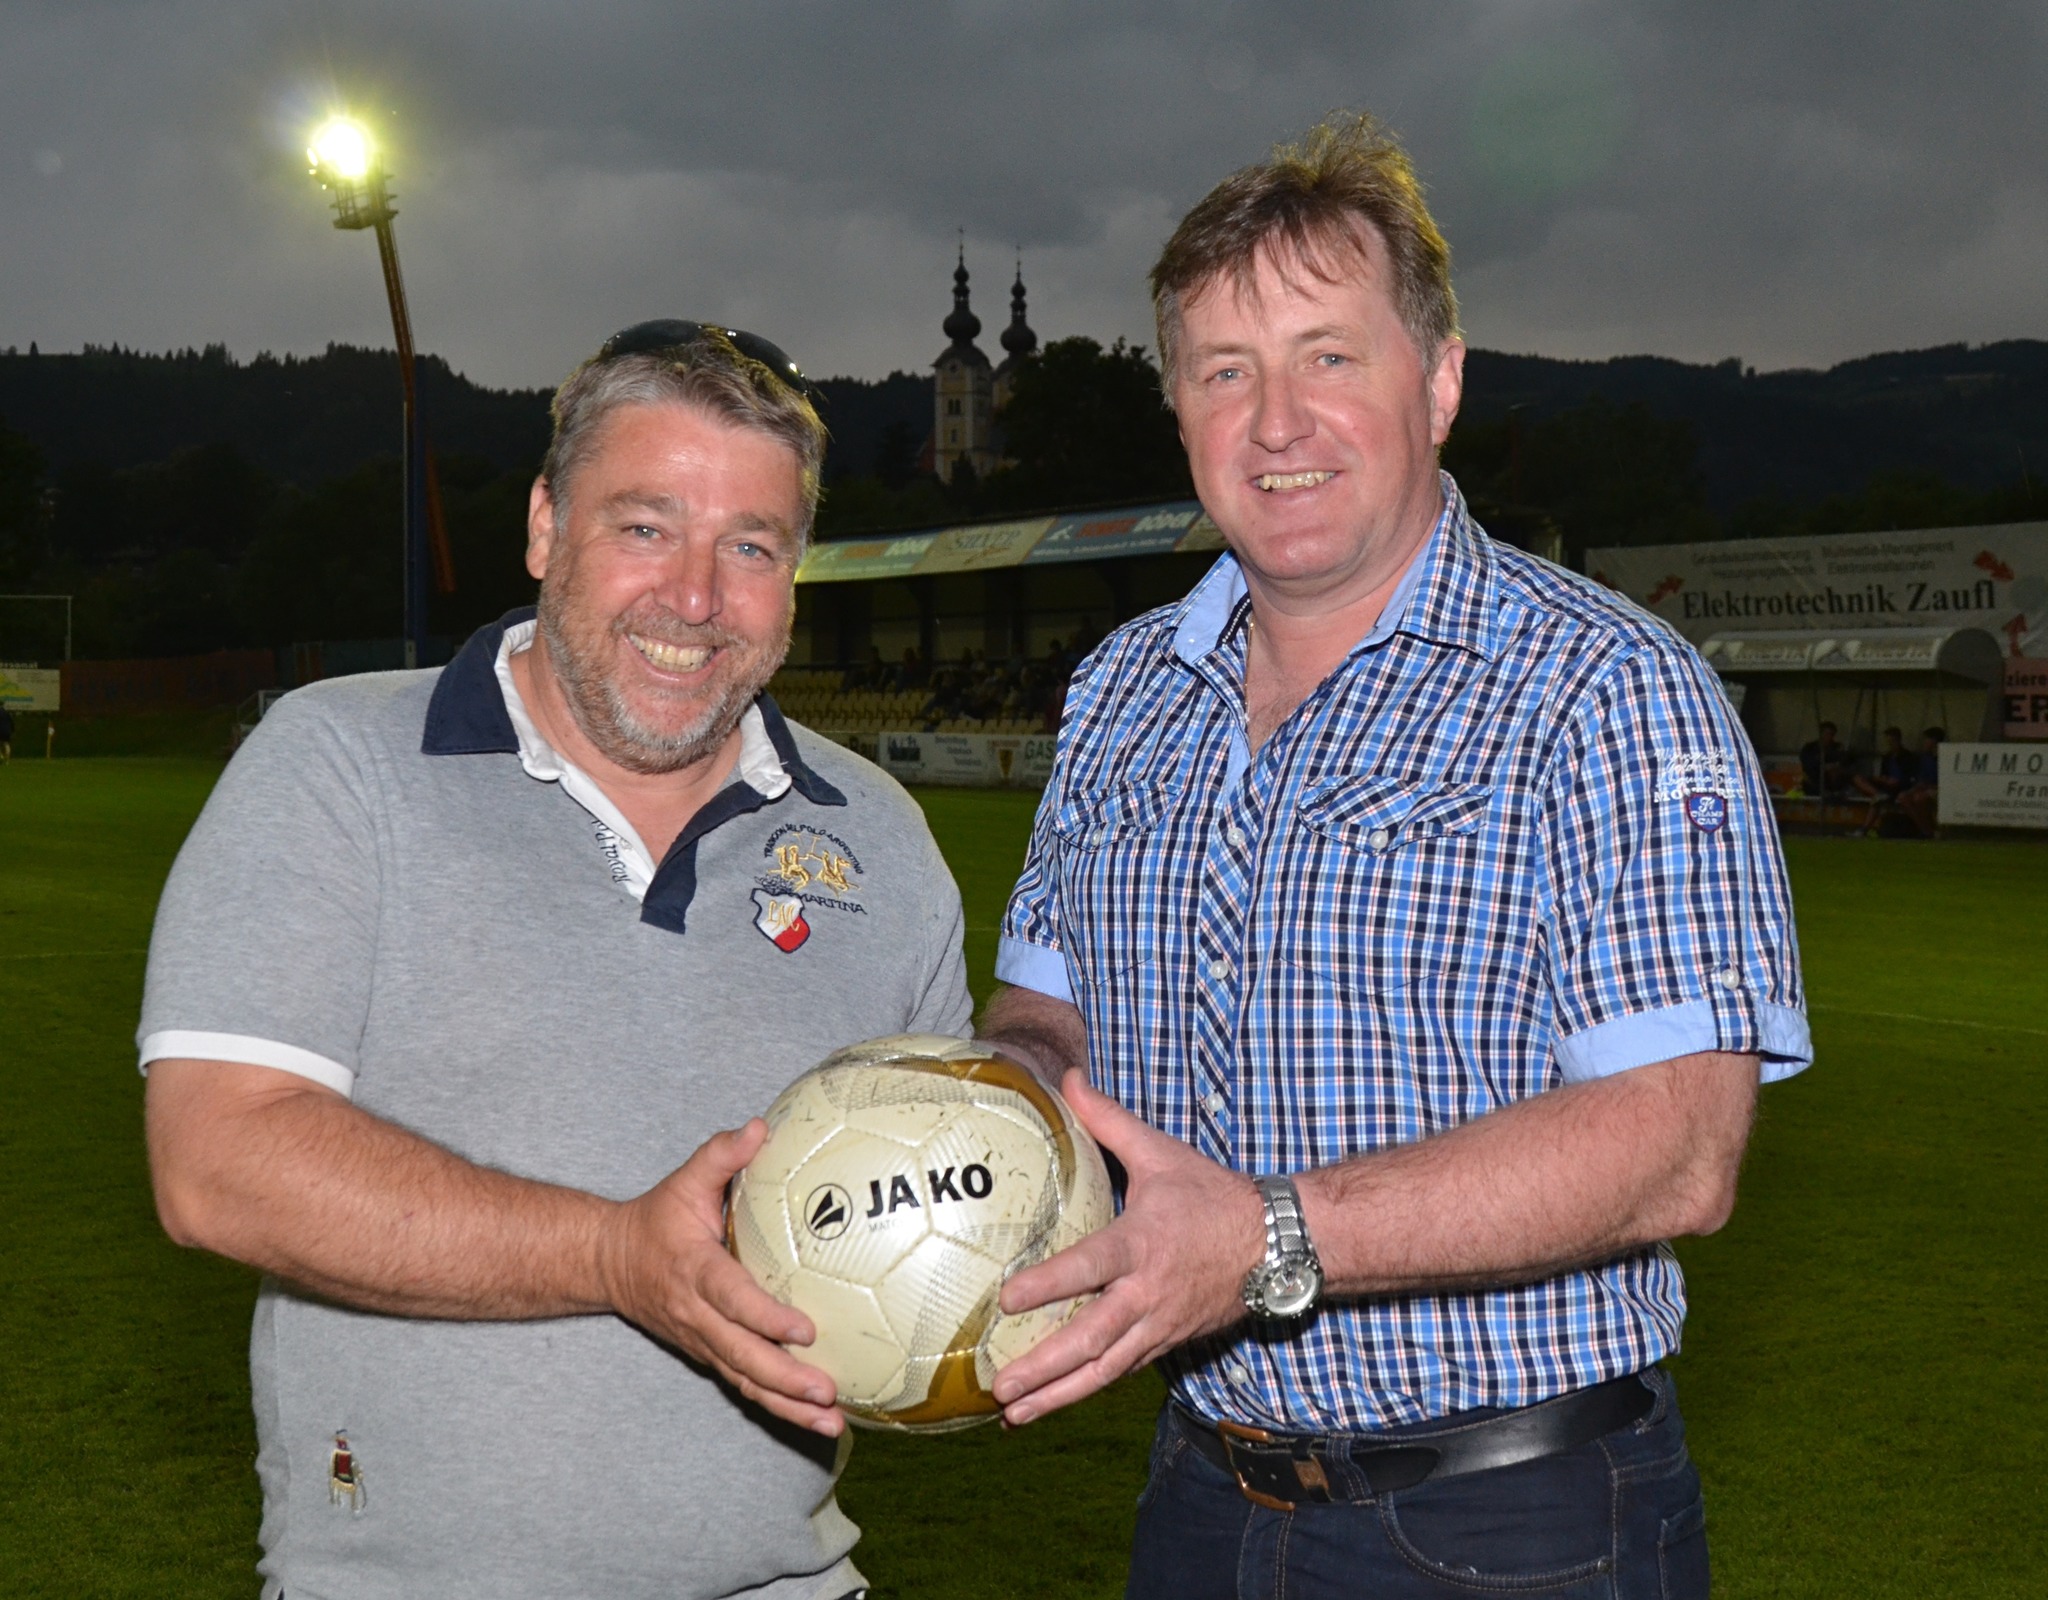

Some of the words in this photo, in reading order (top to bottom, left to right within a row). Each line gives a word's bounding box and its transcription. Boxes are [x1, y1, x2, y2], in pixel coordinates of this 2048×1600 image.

[1683, 583, 1898, 619] Elektrotechnik
[1906, 579, 1996, 612] Zaufl
[1954, 752, 2043, 773] IMMO
[798, 824, 826, 836] POLO
[866, 1163, 993, 1218] JAKO
